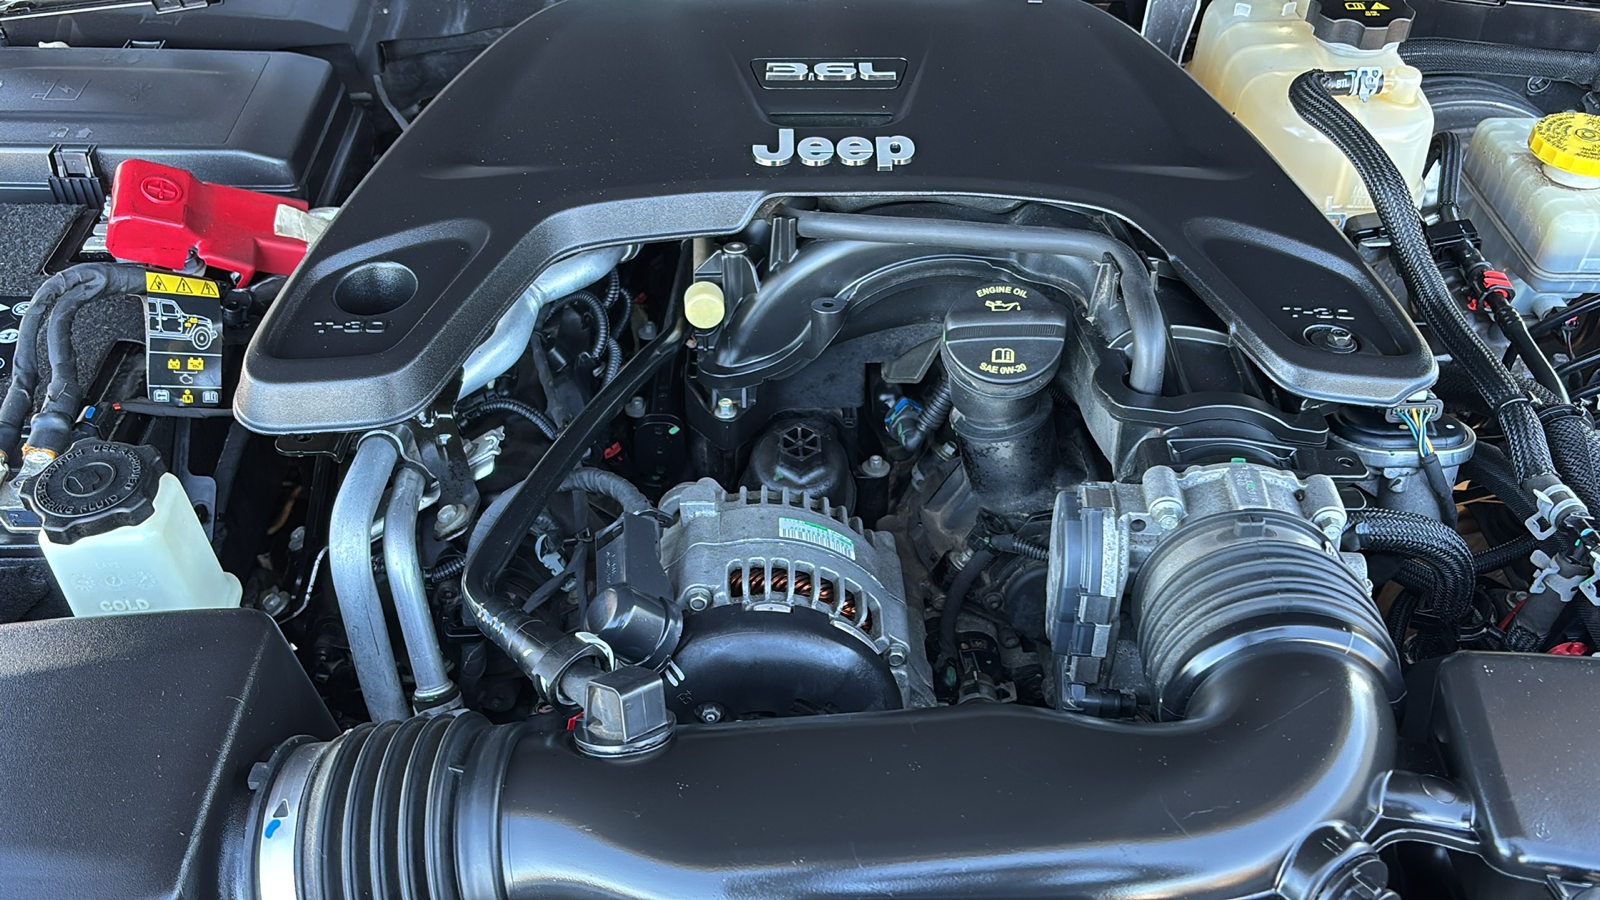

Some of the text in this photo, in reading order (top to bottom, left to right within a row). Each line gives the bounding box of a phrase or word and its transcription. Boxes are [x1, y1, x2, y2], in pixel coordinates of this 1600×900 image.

[765, 62, 897, 81] 3.6L
[752, 128, 916, 171] Jeep
[976, 286, 1028, 299] ENGINE OIL
[979, 362, 1027, 375] SAE 0W-20
[93, 444, 141, 491] USE APPROVED
[37, 448, 119, 514] POWER STEERING FLUID
[99, 599, 150, 612] COLD
